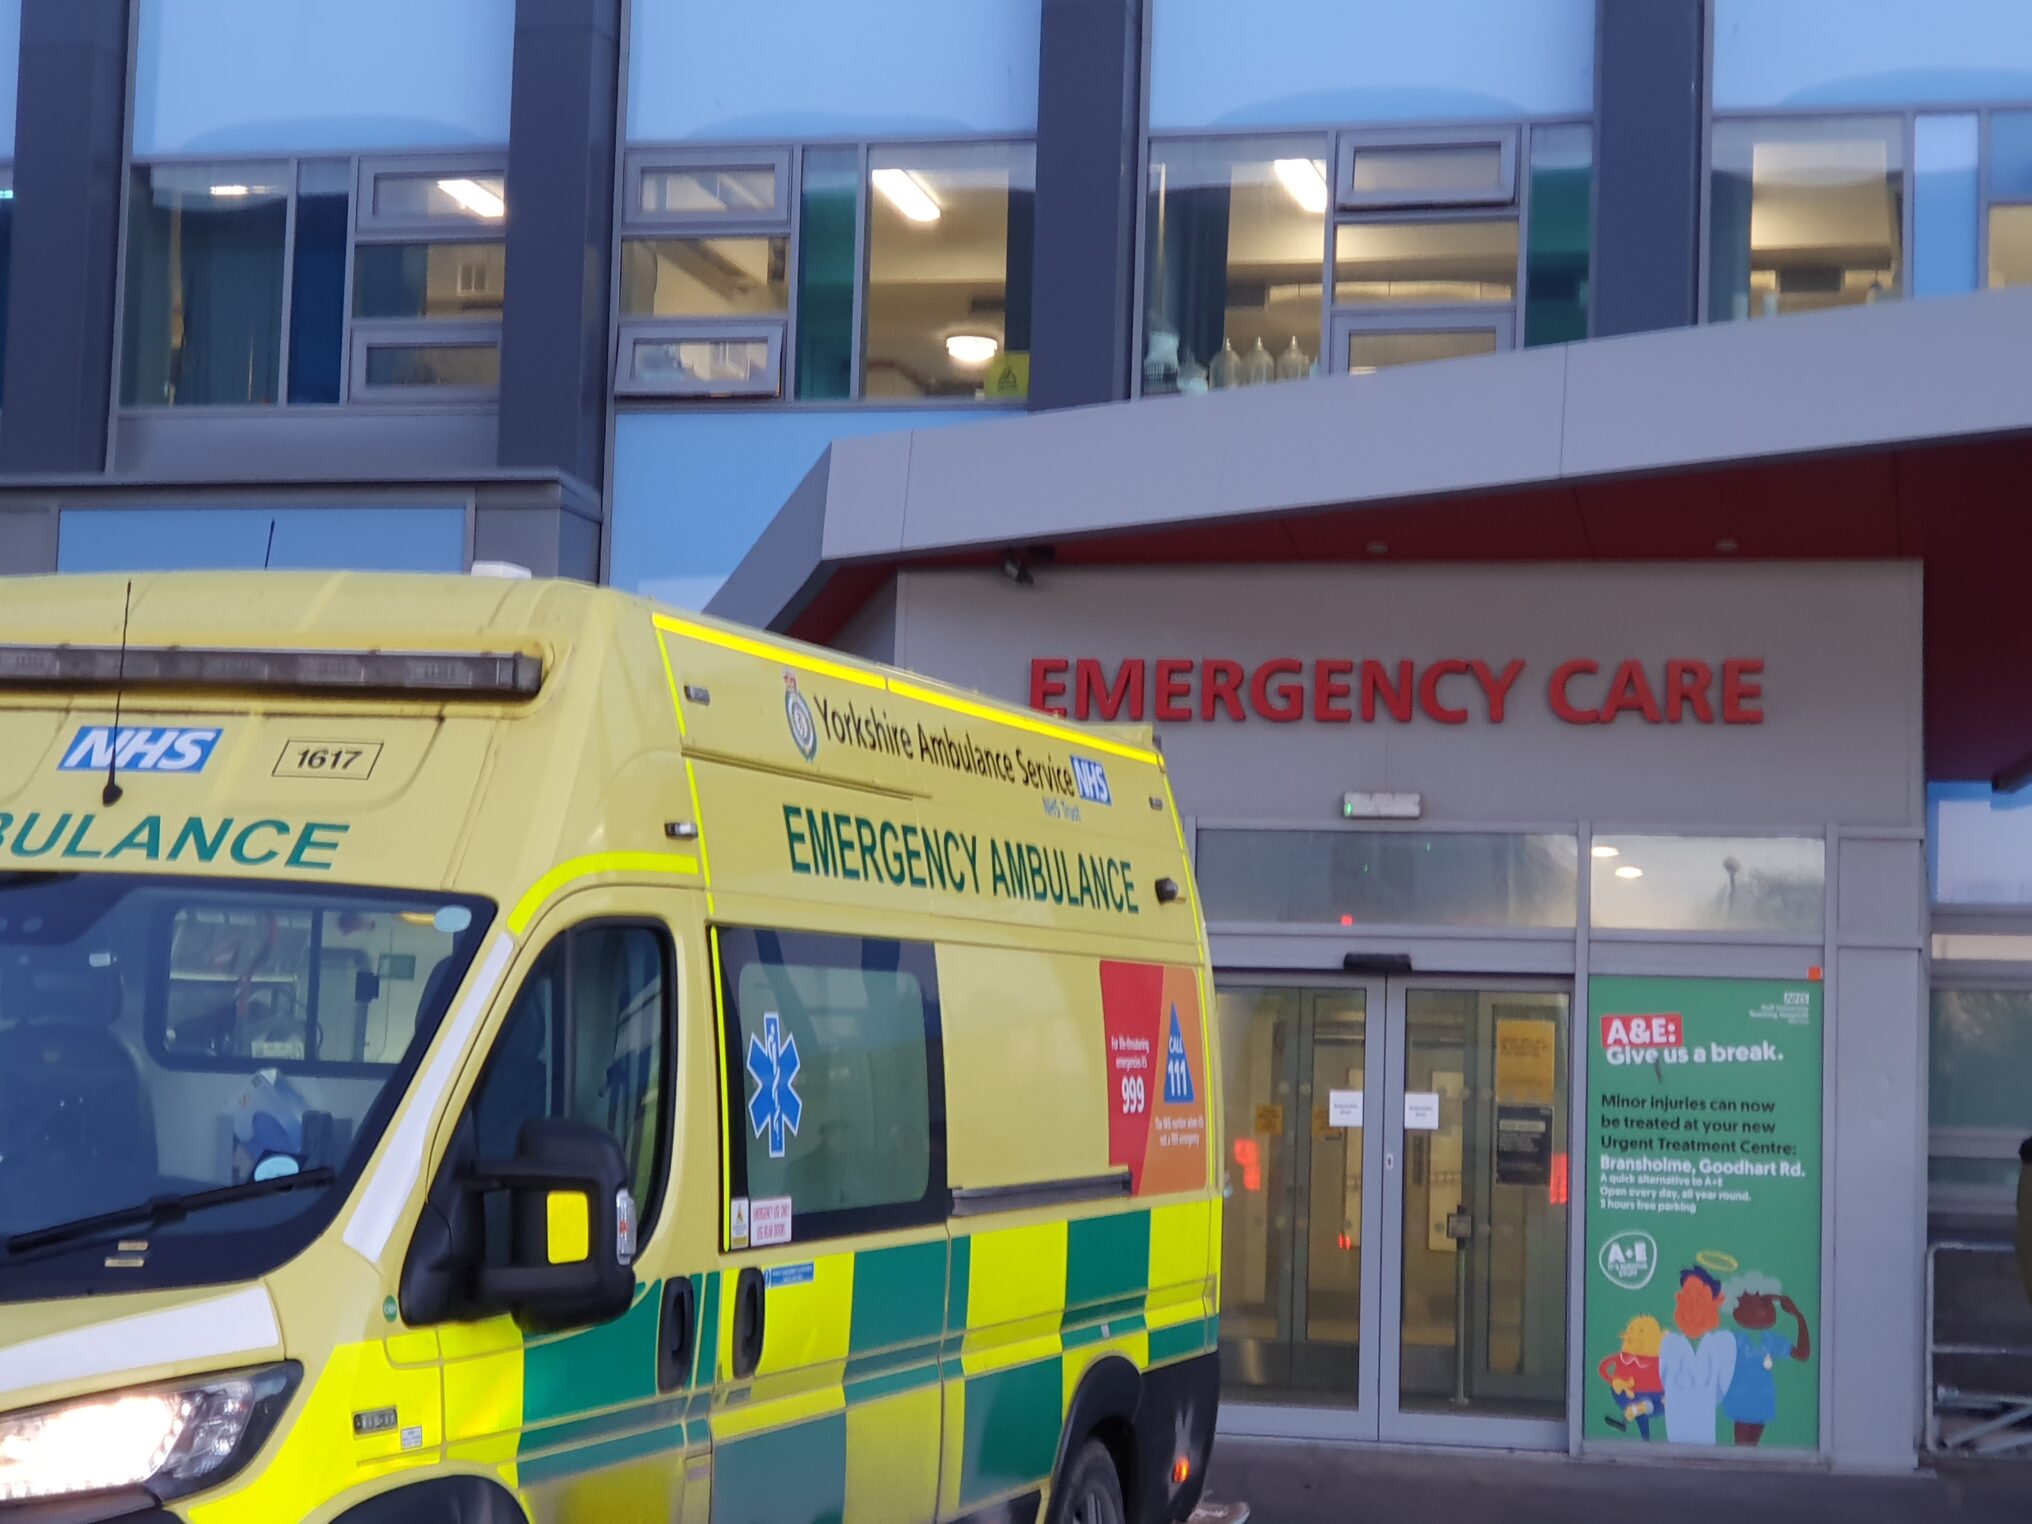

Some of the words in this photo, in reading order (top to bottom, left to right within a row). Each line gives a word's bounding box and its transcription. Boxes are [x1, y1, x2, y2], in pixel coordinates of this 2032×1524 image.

[1029, 658, 1526, 724] EMERGENCY
[1548, 658, 1765, 725] CARE
[63, 727, 216, 770] NHS
[297, 748, 363, 770] 1617
[813, 696, 914, 760] Yorkshire
[917, 722, 1015, 777] Ambulance
[1016, 746, 1076, 797] Service
[1074, 757, 1110, 804] NHS
[0, 811, 350, 871] ULANCE
[782, 804, 981, 895] EMERGENCY
[990, 838, 1140, 914] AMBULANCE
[1606, 1016, 1677, 1045] A&E:
[1168, 1035, 1184, 1054] CALL
[1606, 1045, 1659, 1066] Give
[1663, 1046, 1690, 1065] us
[1693, 1047, 1707, 1063] a
[1711, 1040, 1784, 1063] break.
[1167, 1059, 1188, 1097] 111
[1121, 1075, 1146, 1115] 999
[1601, 1094, 1647, 1109] Minor
[1650, 1095, 1706, 1112] injuries
[1709, 1098, 1737, 1111] can
[1740, 1099, 1776, 1113] now
[1601, 1114, 1620, 1129] be
[1624, 1115, 1680, 1131] treated
[1684, 1117, 1699, 1131] at
[1702, 1119, 1738, 1134] your
[1742, 1120, 1776, 1134] new
[1601, 1135, 1654, 1153] Urgent
[1657, 1137, 1736, 1154] Treatment
[1740, 1140, 1797, 1155] Centre:
[1600, 1154, 1697, 1176] Bransholme,
[1699, 1158, 1777, 1176] Goodhart
[1780, 1161, 1806, 1177] Rd.
[1657, 1201, 1697, 1215] parking
